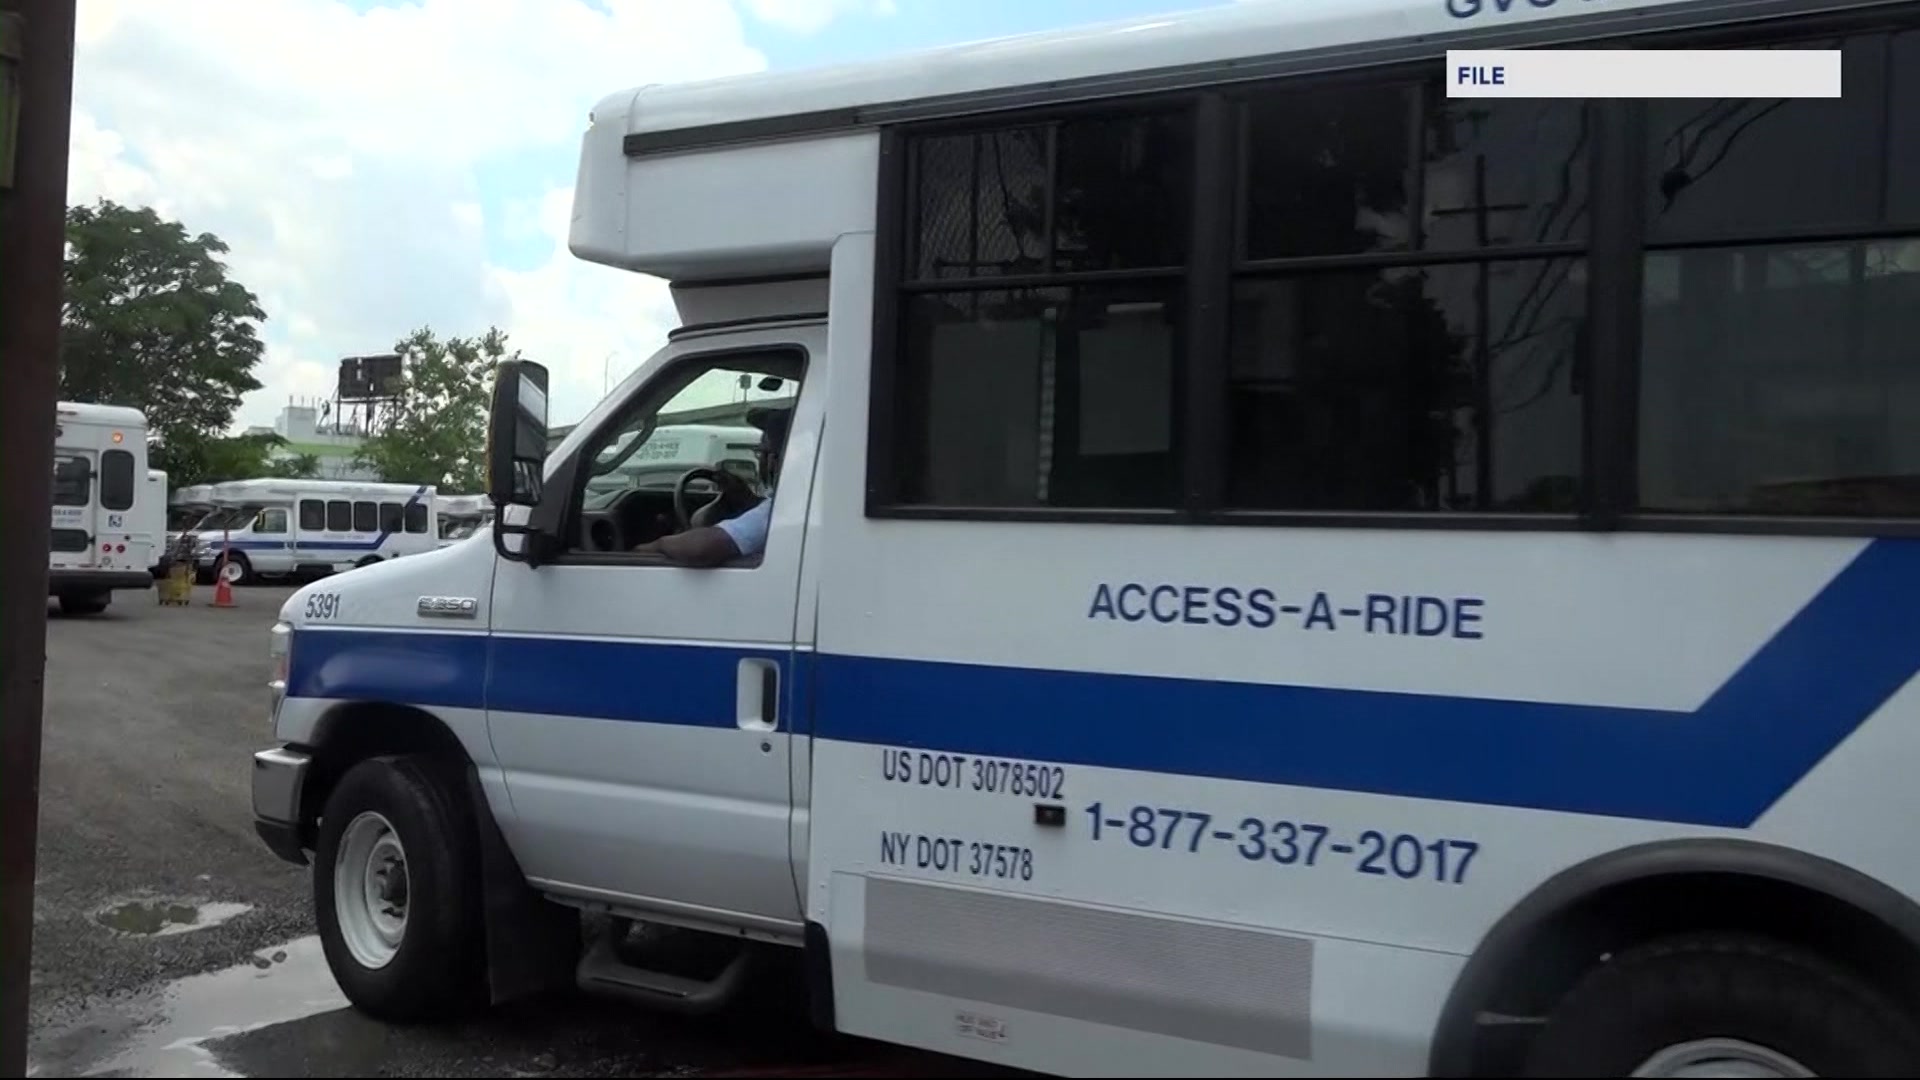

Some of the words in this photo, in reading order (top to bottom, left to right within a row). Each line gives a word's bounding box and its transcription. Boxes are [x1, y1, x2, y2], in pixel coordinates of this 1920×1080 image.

[305, 593, 341, 619] 5391
[1088, 583, 1484, 640] ACCESS-A-RIDE
[883, 749, 912, 783] US
[919, 753, 967, 789] DOT
[971, 758, 1065, 800] 3078502
[881, 830, 911, 865] NY
[916, 835, 965, 873] DOT
[969, 841, 1034, 881] 37578
[1085, 802, 1480, 884] 1-877-337-2017
